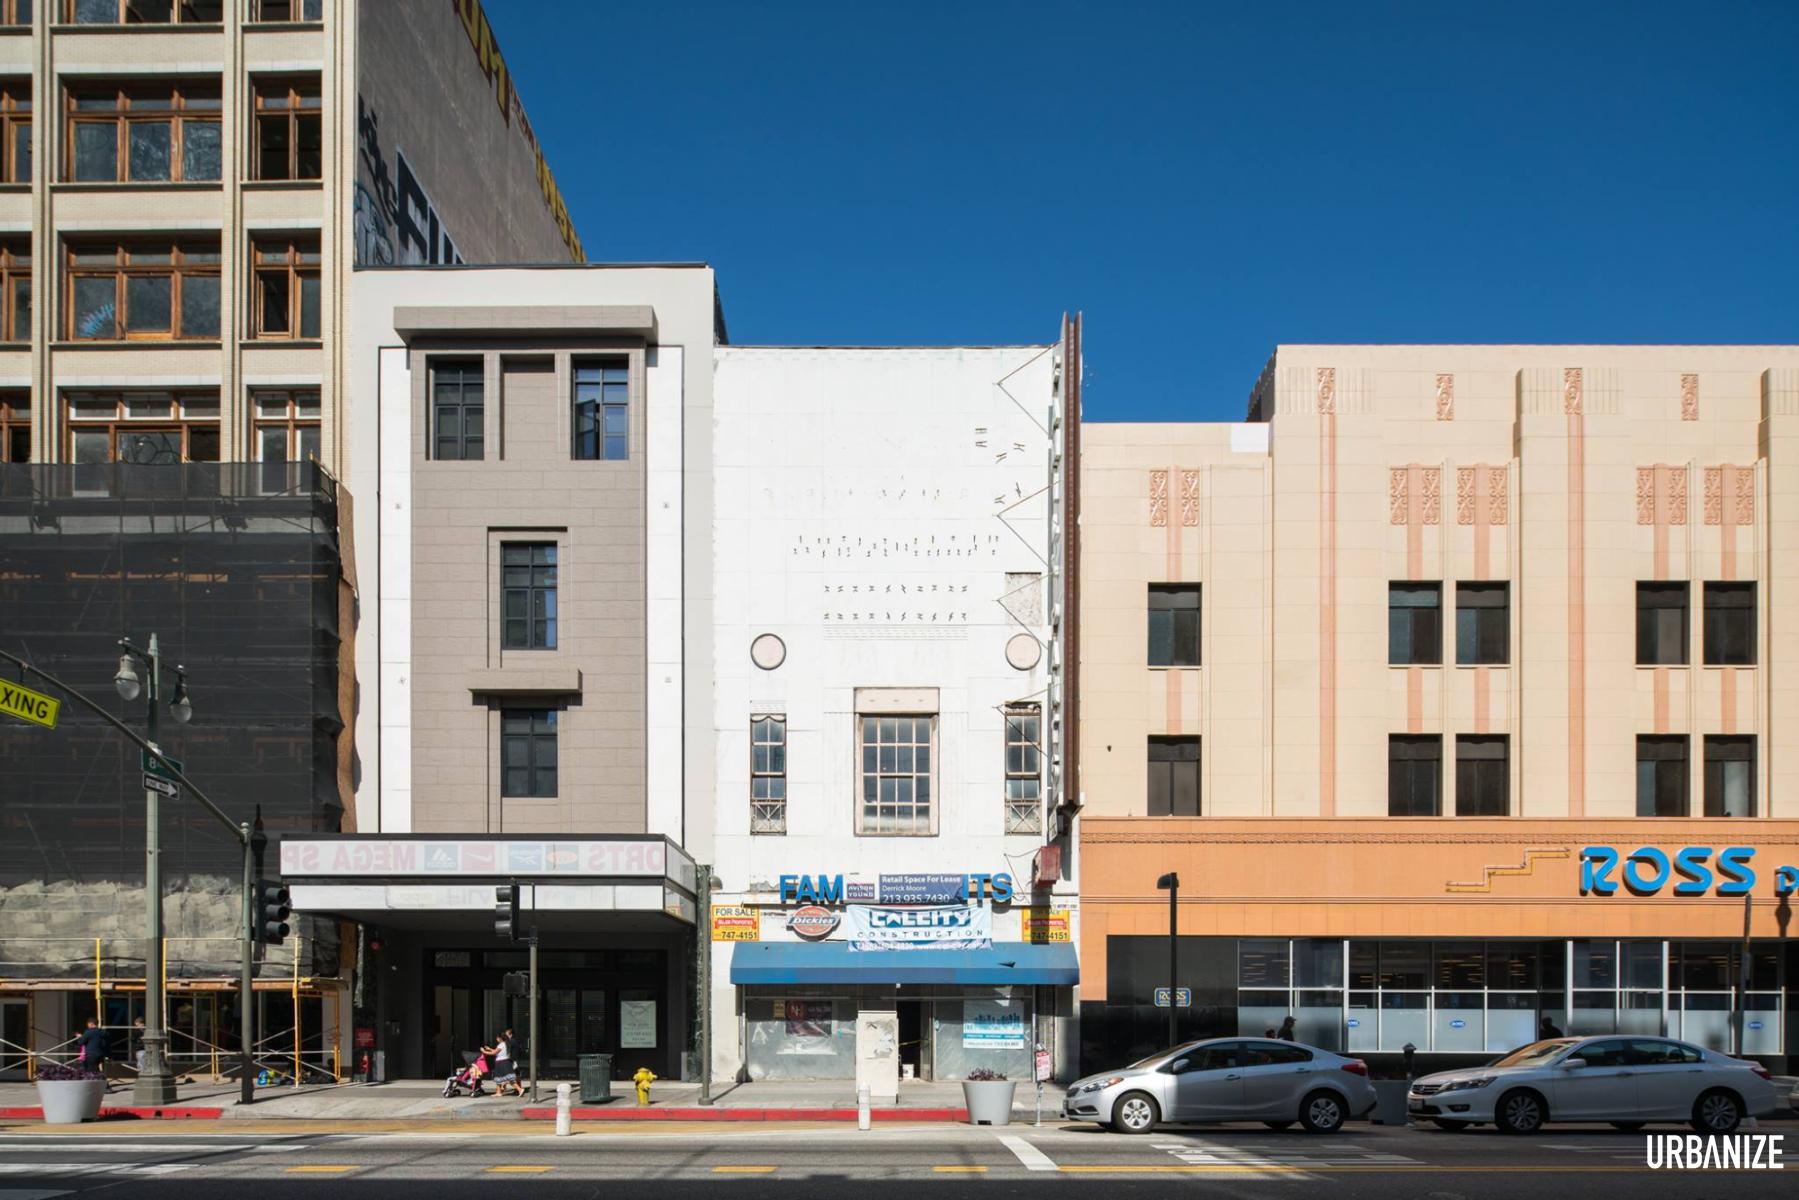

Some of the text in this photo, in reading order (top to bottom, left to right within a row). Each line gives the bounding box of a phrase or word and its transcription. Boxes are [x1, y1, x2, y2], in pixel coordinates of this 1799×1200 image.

[1, 687, 49, 719] XING
[1580, 846, 1757, 894] ROSS
[904, 876, 925, 885] Space
[715, 908, 755, 917] FOR SALE
[792, 916, 834, 924] Dickies
[722, 931, 757, 939] 747-4151
[857, 930, 983, 939] CONSTRUCTION
